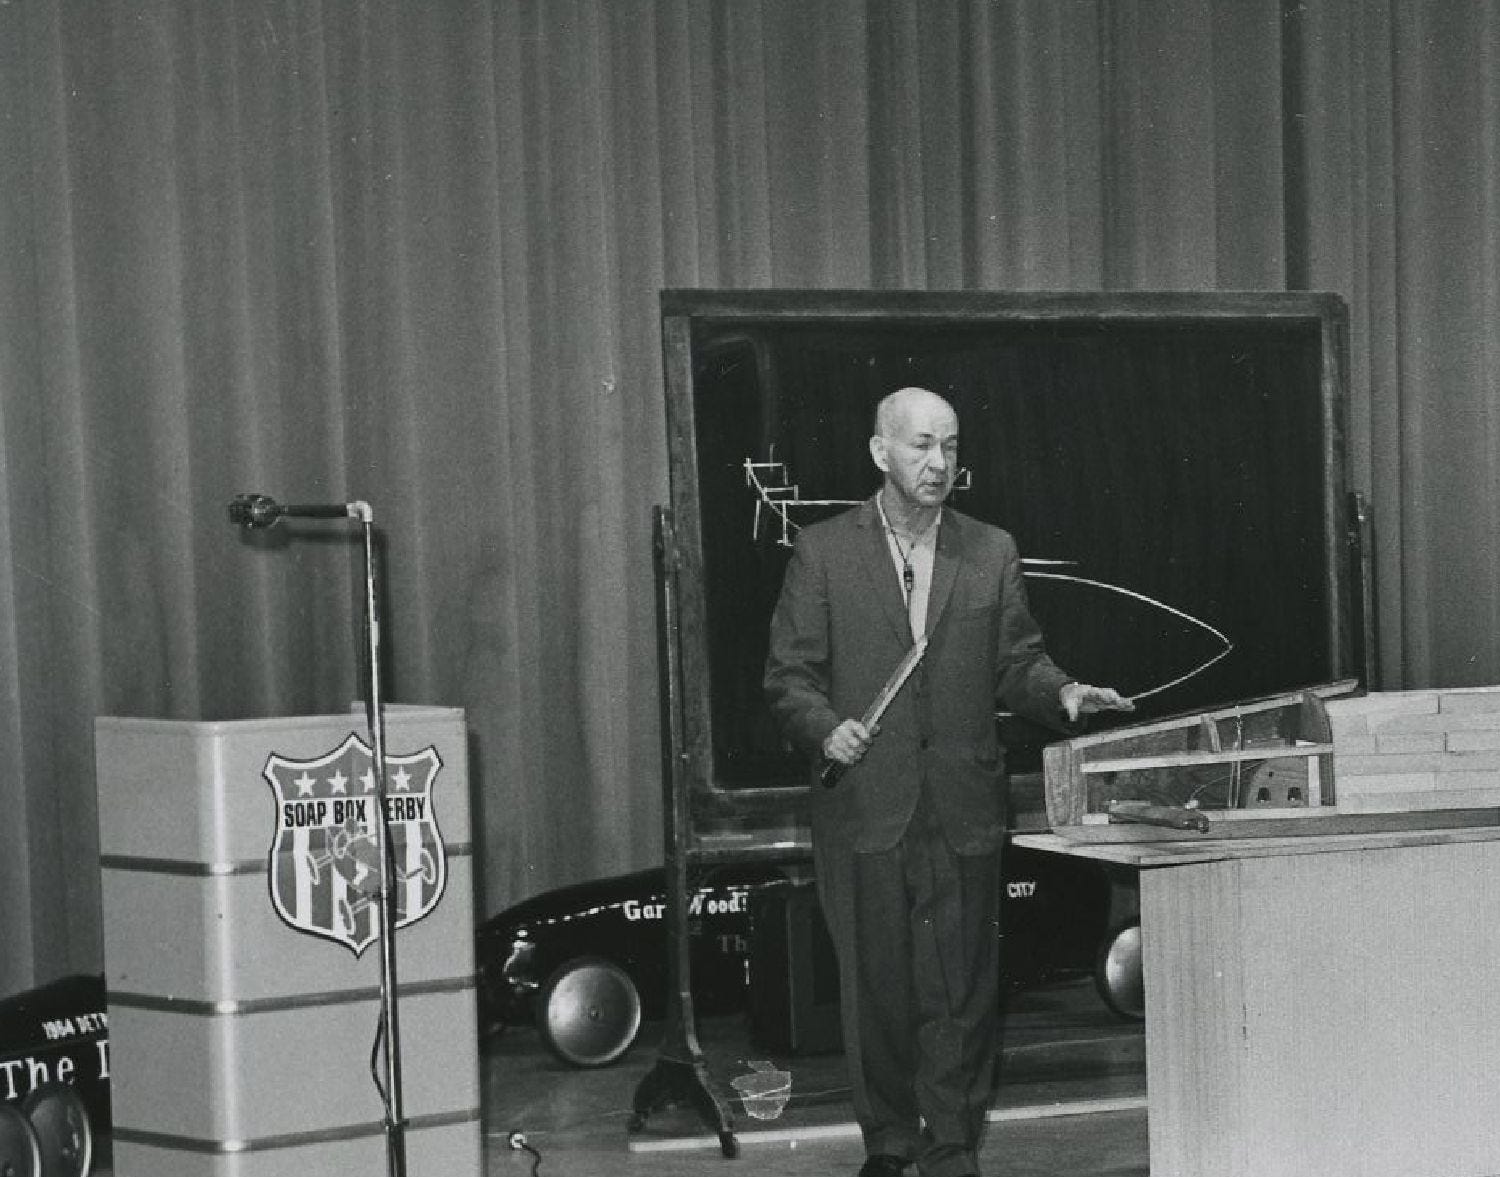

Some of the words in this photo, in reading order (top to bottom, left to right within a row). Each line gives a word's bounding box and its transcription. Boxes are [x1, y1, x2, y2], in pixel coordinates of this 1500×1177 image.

[284, 802, 327, 828] SOAP
[334, 799, 366, 825] BOX
[380, 797, 425, 822] ERBY
[1007, 881, 1036, 898] CITY
[623, 899, 667, 921] Gar
[0, 1055, 75, 1100] The
